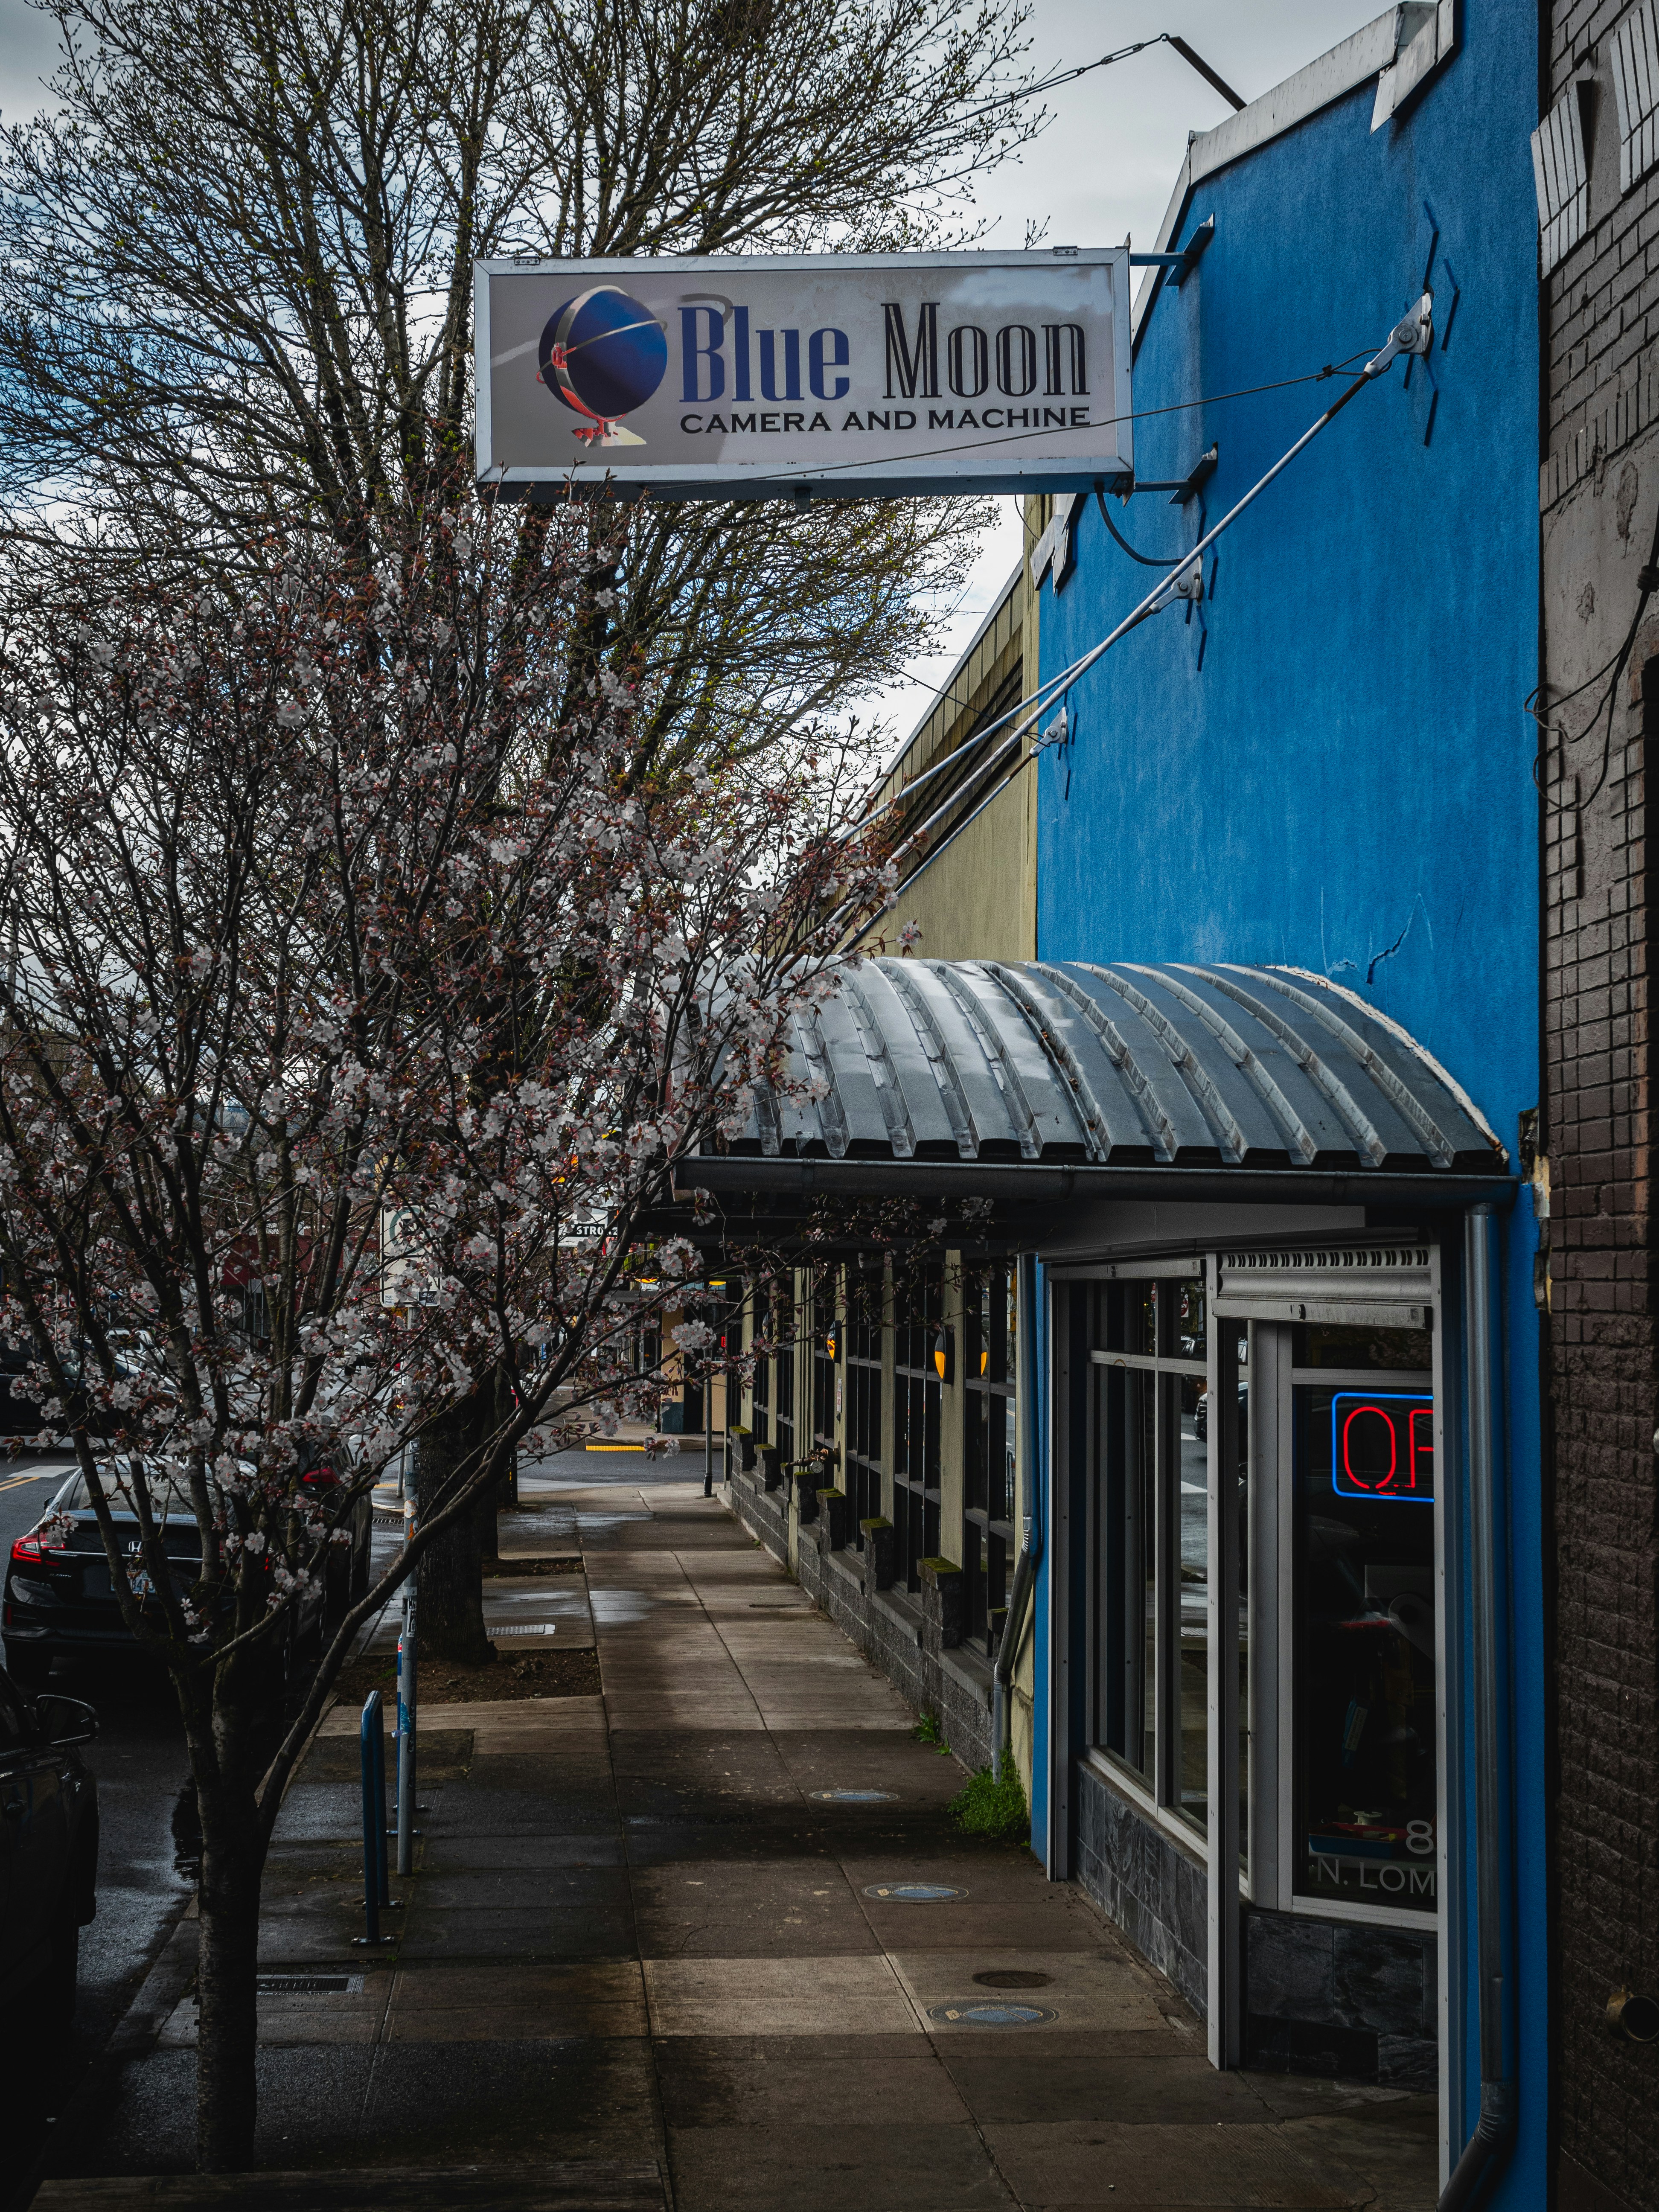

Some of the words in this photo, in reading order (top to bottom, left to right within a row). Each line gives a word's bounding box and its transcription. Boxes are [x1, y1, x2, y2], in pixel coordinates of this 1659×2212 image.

[678, 306, 850, 402] Blue
[881, 302, 1091, 400] Moon
[680, 411, 830, 434] CAMERA
[841, 410, 917, 431] AND
[927, 406, 1091, 429] MACHINE
[1406, 1819, 1434, 1854] 8
[1317, 1857, 1348, 1886] N.
[1359, 1861, 1435, 1897] LOM
